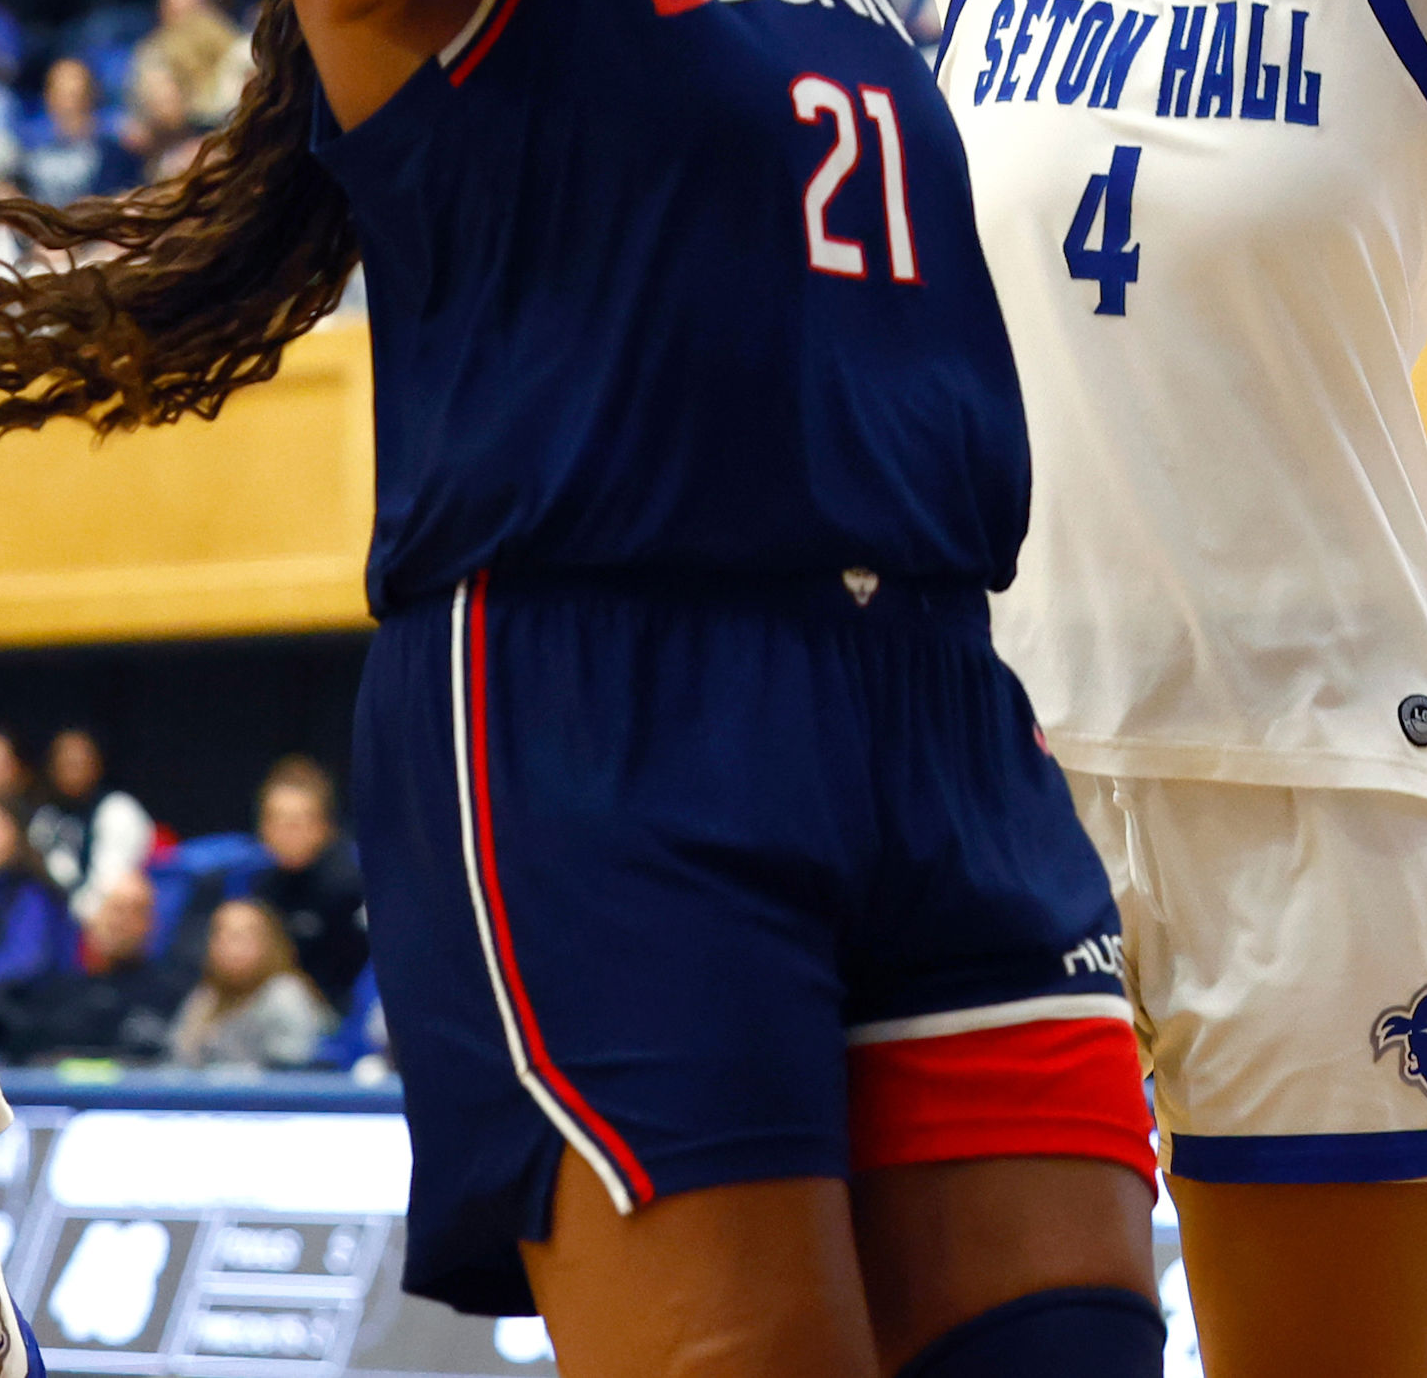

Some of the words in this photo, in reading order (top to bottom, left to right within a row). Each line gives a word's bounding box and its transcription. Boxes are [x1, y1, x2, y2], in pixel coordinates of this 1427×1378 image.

[1156, 1, 1321, 126] HALL
[790, 72, 925, 286] 21
[1063, 145, 1142, 316] 4
